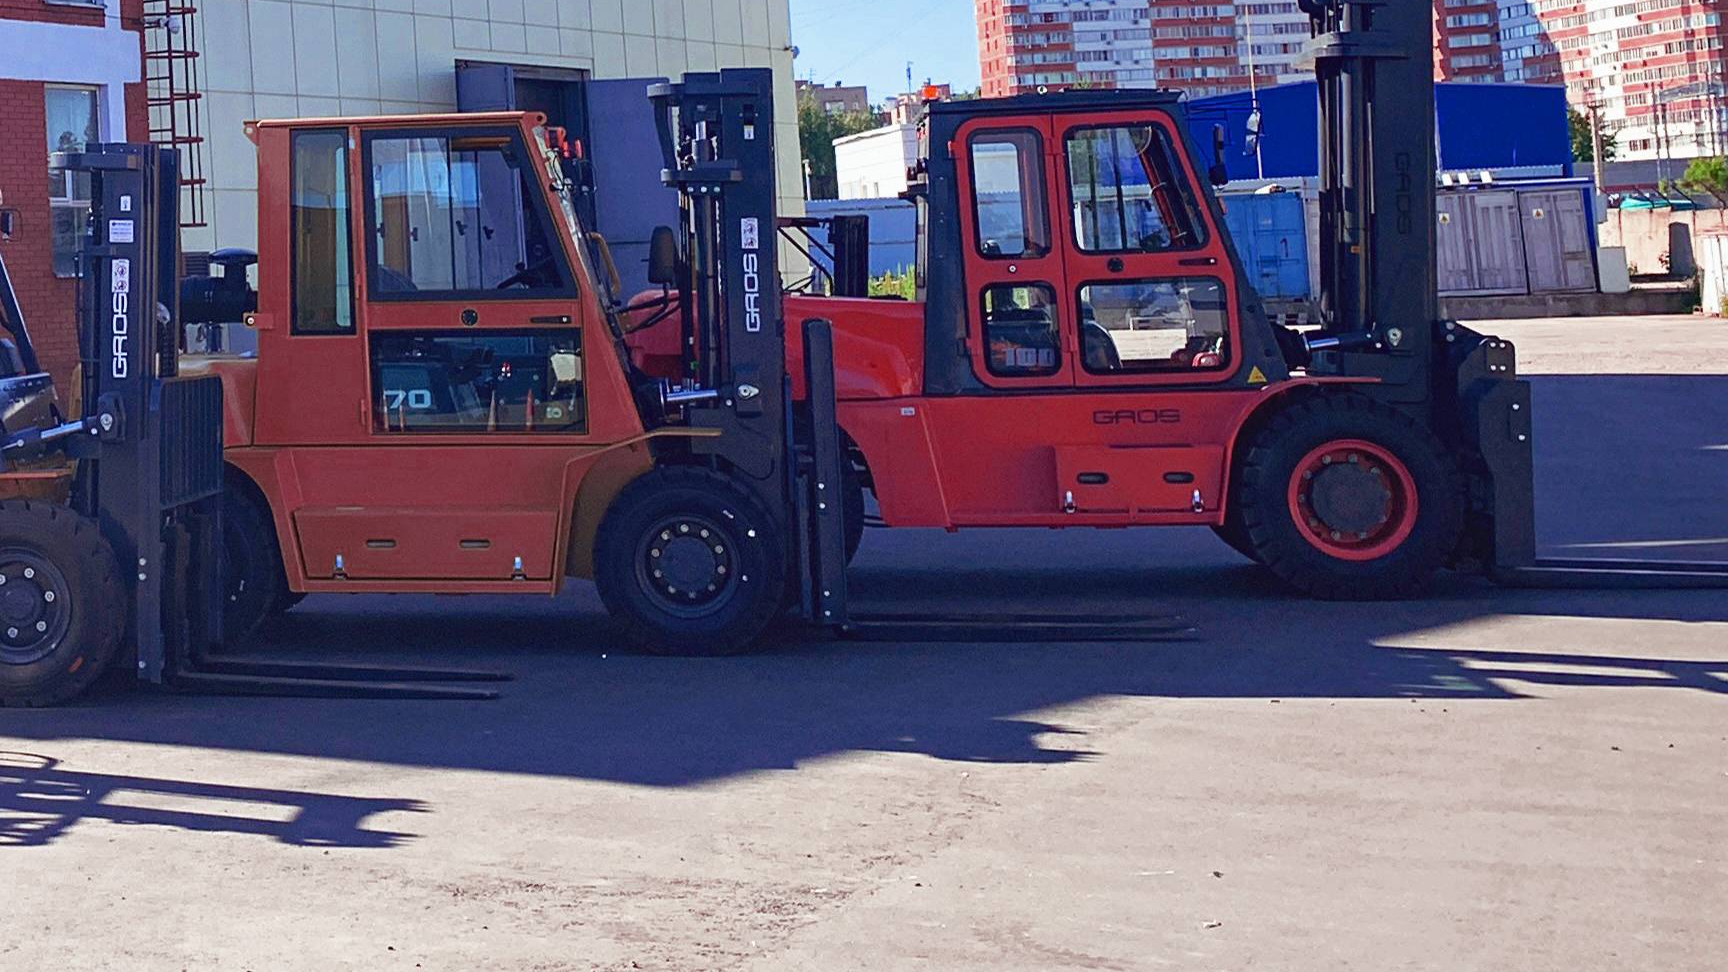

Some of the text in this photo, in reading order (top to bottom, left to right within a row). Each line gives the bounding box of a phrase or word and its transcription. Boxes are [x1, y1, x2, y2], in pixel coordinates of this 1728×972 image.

[743, 252, 761, 333] GROS
[112, 291, 128, 379] GROS
[383, 389, 432, 410] 70
[1092, 409, 1181, 425] GROS
